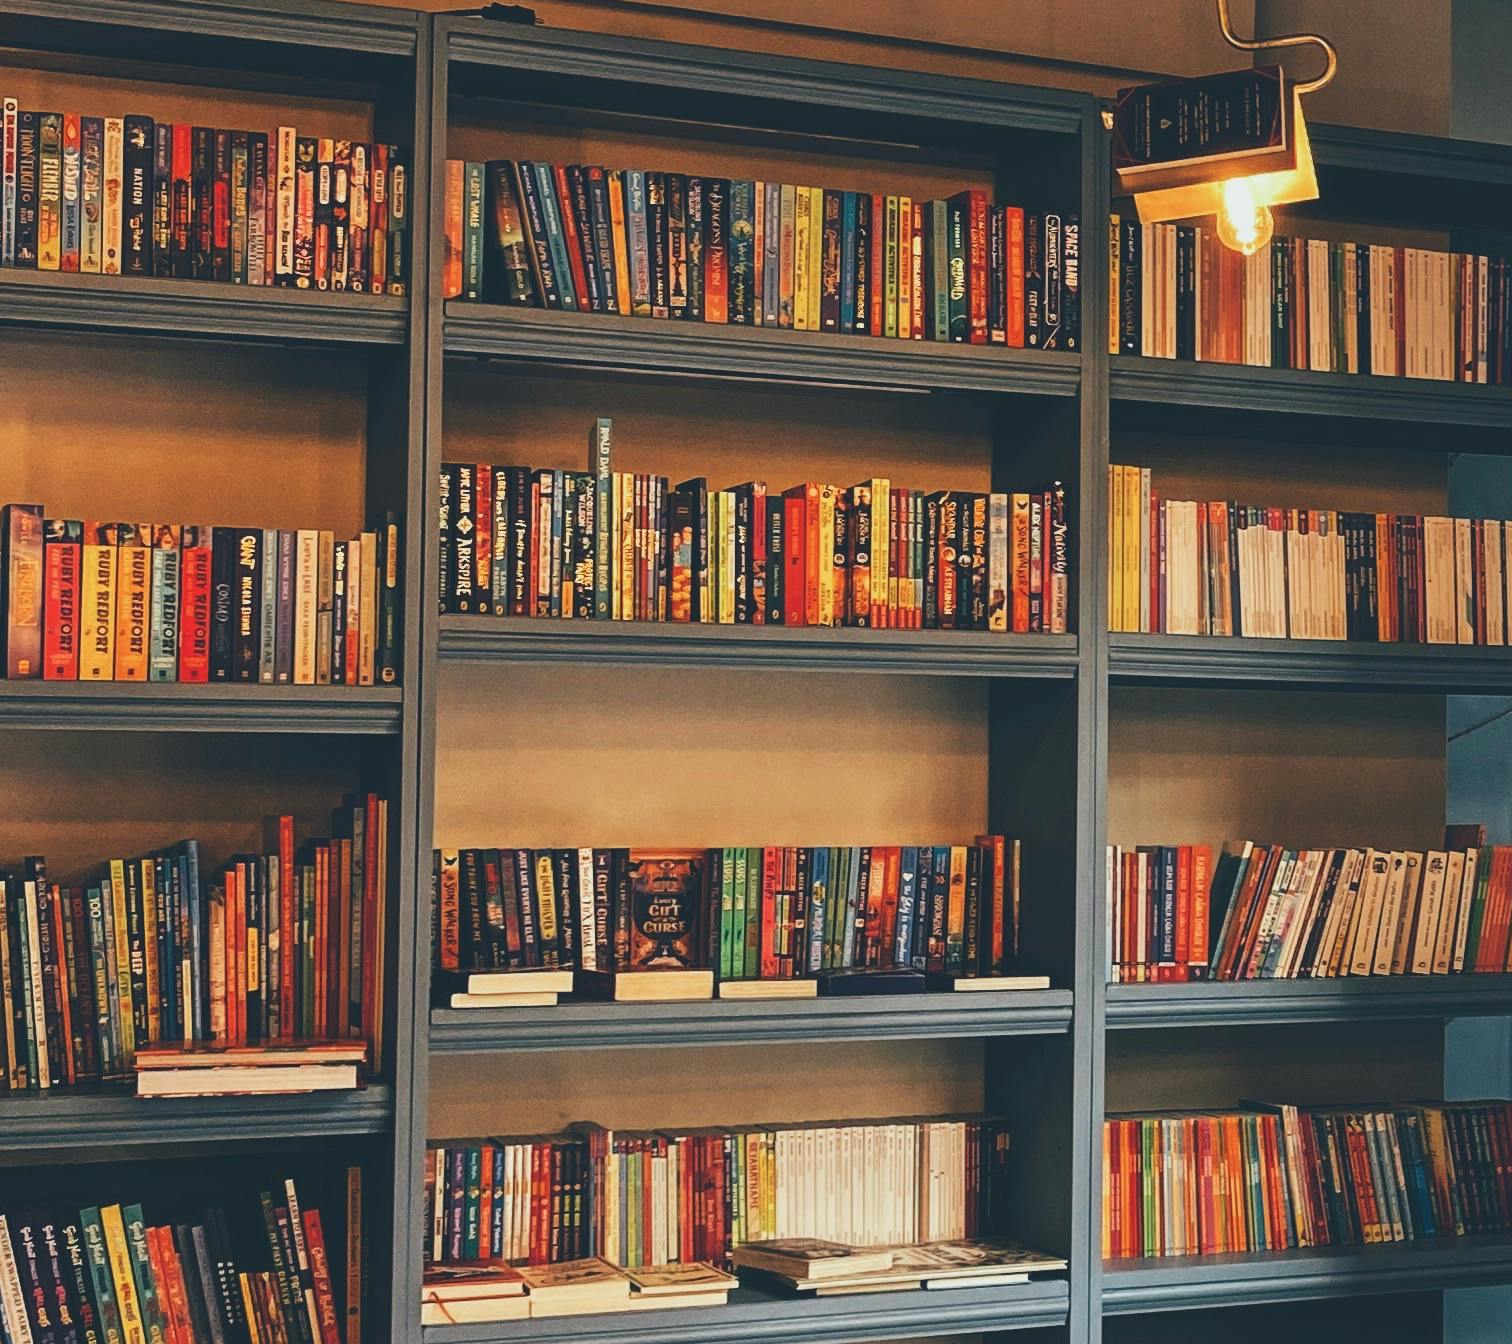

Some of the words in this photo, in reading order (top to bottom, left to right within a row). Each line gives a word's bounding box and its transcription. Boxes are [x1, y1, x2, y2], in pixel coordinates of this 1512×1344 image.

[132, 168, 143, 205] NATION
[62, 547, 73, 585] RUBY
[61, 589, 72, 655] REDFORT
[643, 922, 685, 934] CURSE
[649, 906, 681, 917] GIFT
